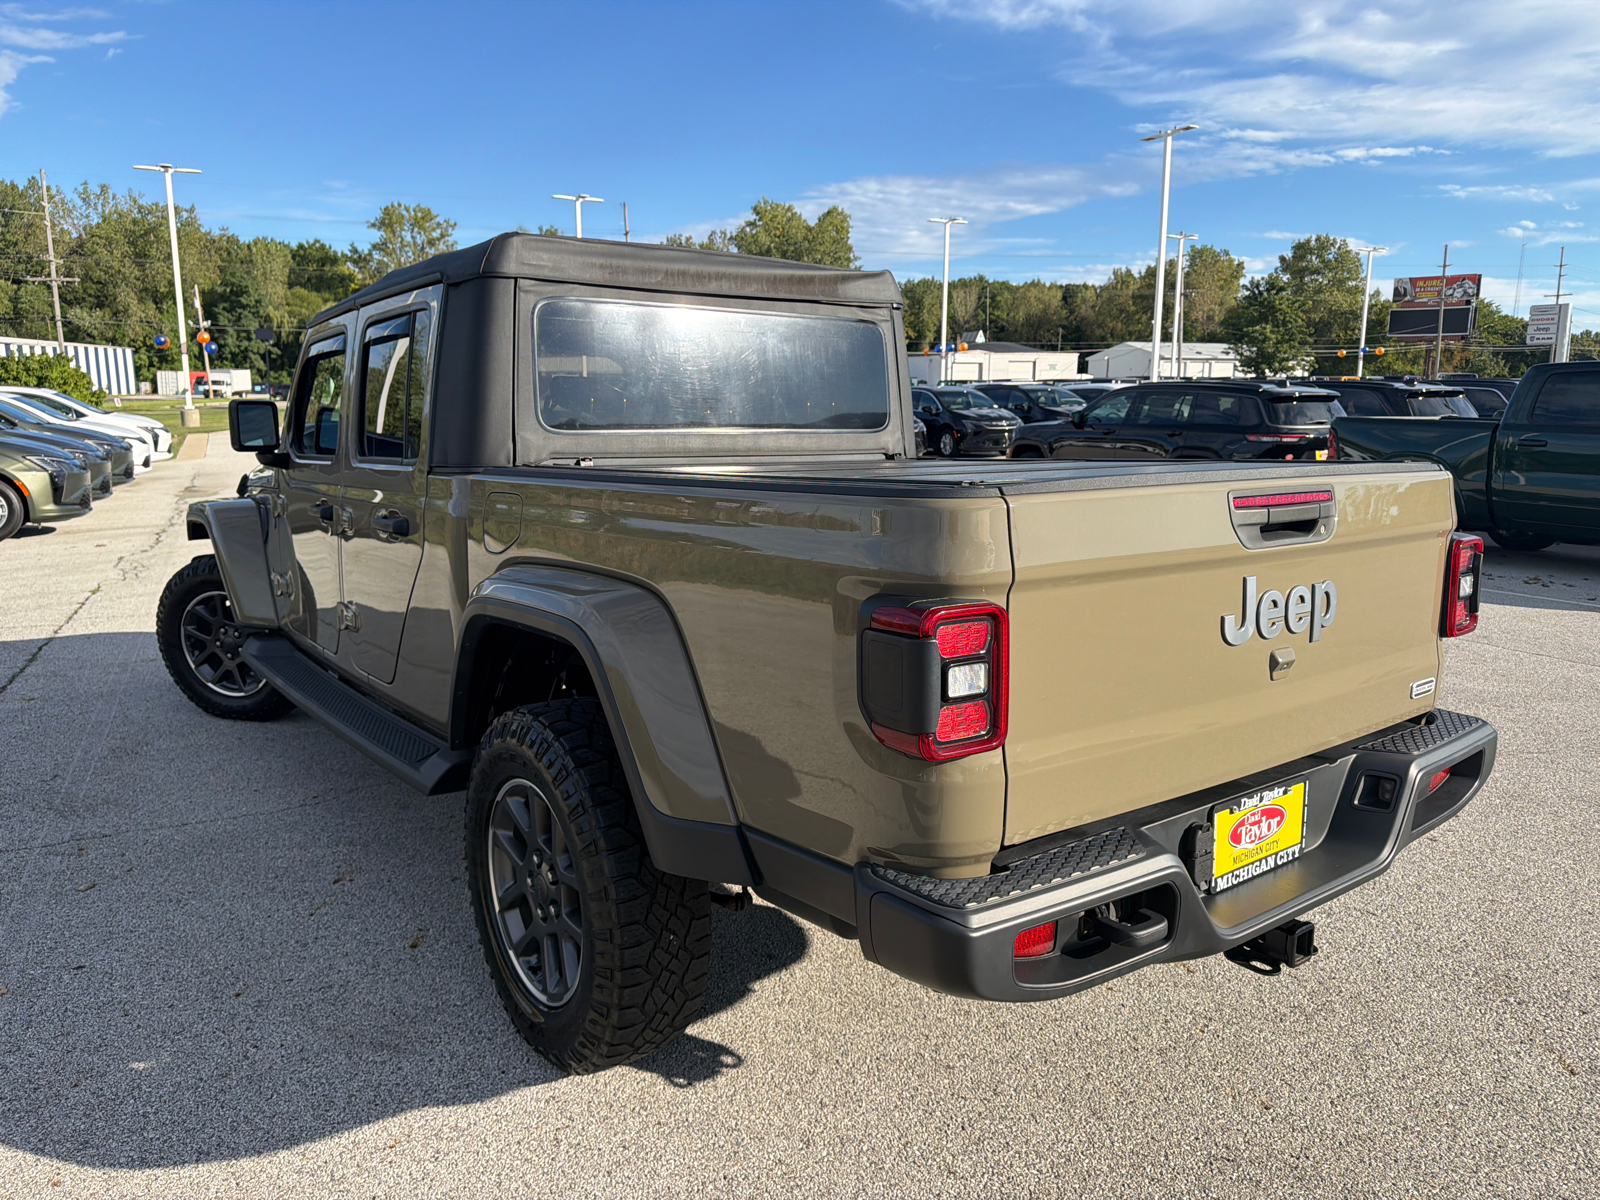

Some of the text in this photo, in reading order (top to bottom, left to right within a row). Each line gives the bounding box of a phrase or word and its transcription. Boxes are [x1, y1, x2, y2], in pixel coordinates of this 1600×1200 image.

[1416, 279, 1445, 287] INJURE
[1220, 575, 1338, 647] Jeep
[1240, 787, 1286, 811] David Taylor
[1237, 815, 1281, 846] Taylor
[1244, 810, 1262, 825] David
[1233, 839, 1280, 867] MICHIGAN CITY
[1216, 843, 1302, 892] MICHIGAN CITY
